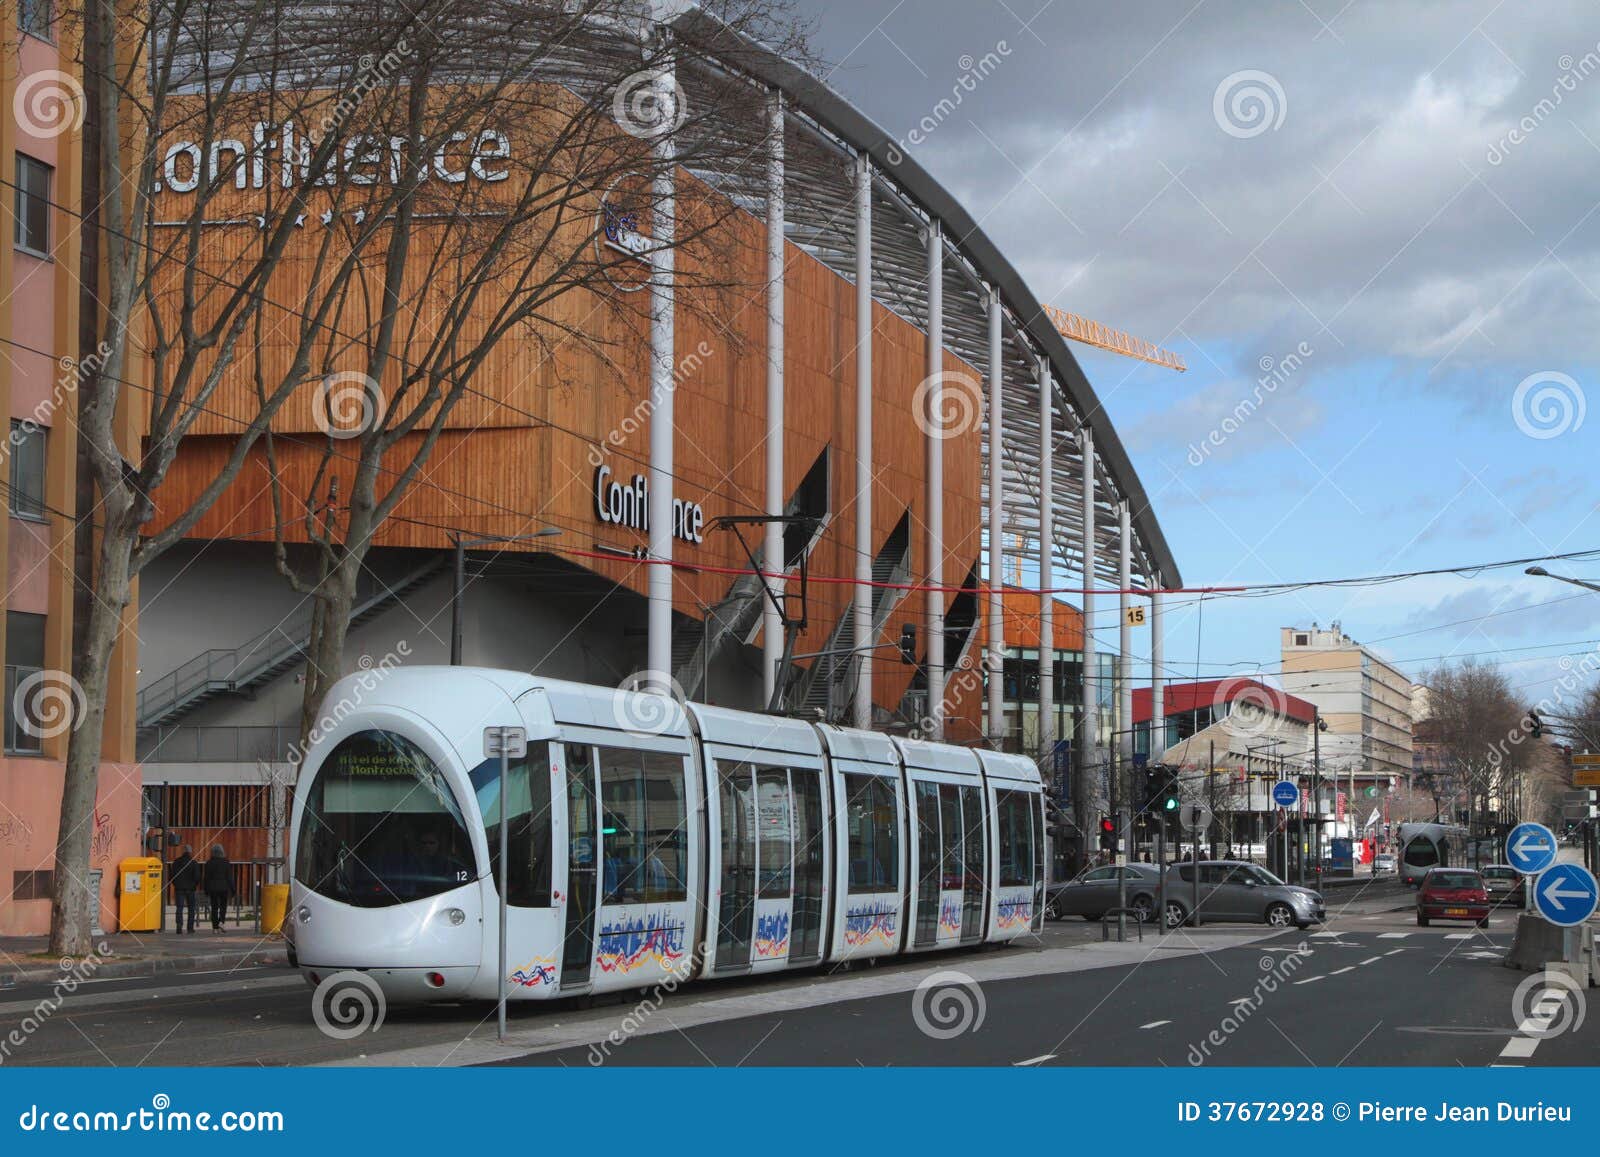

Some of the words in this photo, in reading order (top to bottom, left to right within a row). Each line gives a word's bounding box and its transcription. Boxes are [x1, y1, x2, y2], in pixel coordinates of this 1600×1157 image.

[596, 464, 703, 544] Conflnce
[1128, 611, 1143, 623] 15
[456, 871, 468, 881] 12
